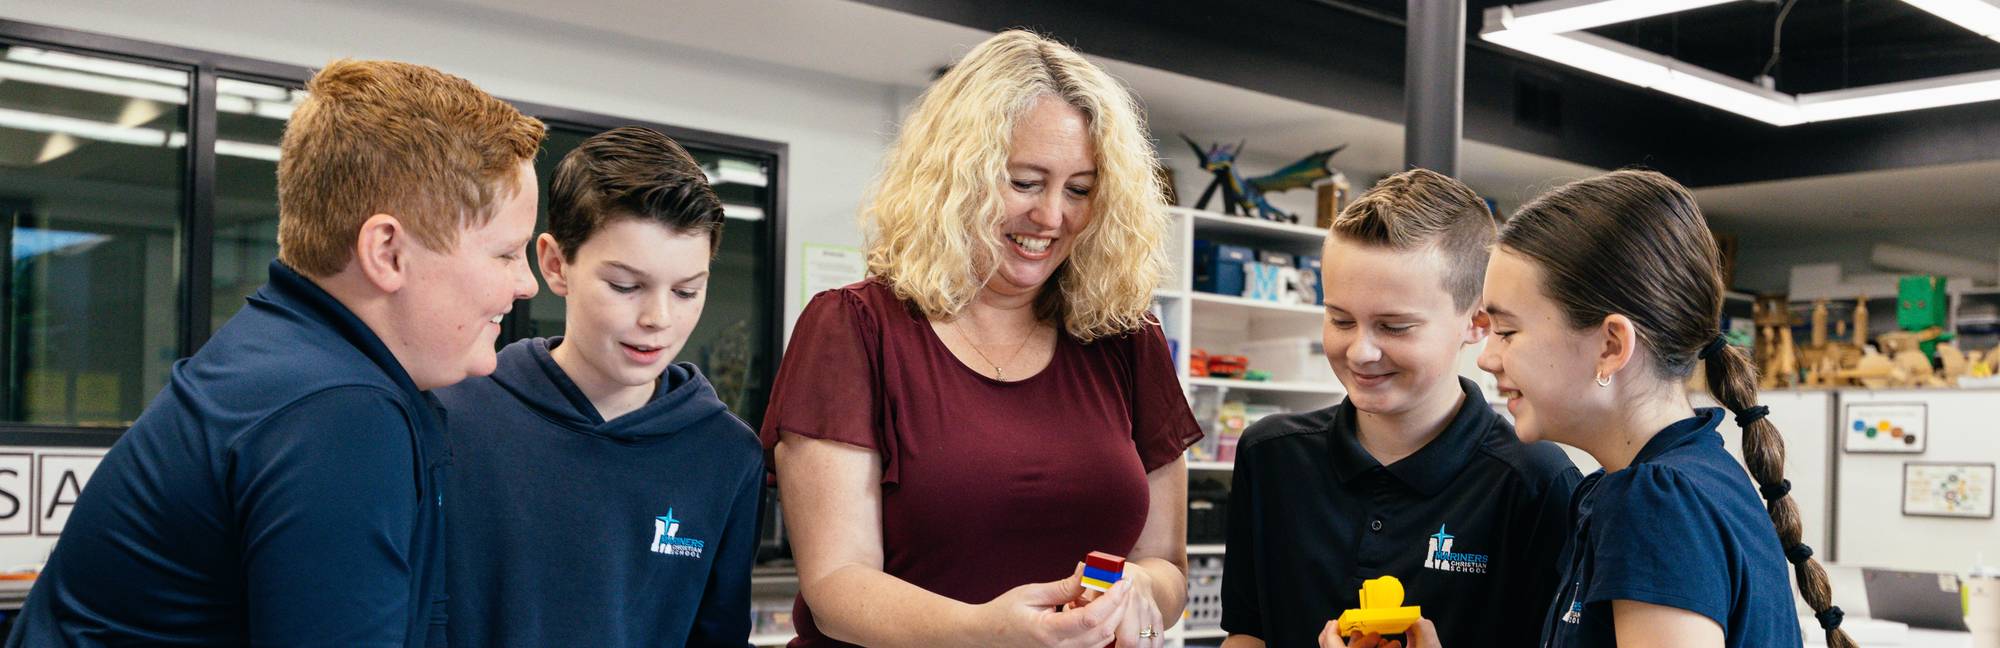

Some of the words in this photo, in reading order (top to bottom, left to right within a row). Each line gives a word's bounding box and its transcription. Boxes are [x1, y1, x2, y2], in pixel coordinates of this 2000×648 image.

[671, 549, 701, 559] SCHOOL
[1434, 550, 1489, 563] MARINERS
[1450, 560, 1487, 568] CHRISTIAN
[1450, 565, 1487, 574] SCHOOL
